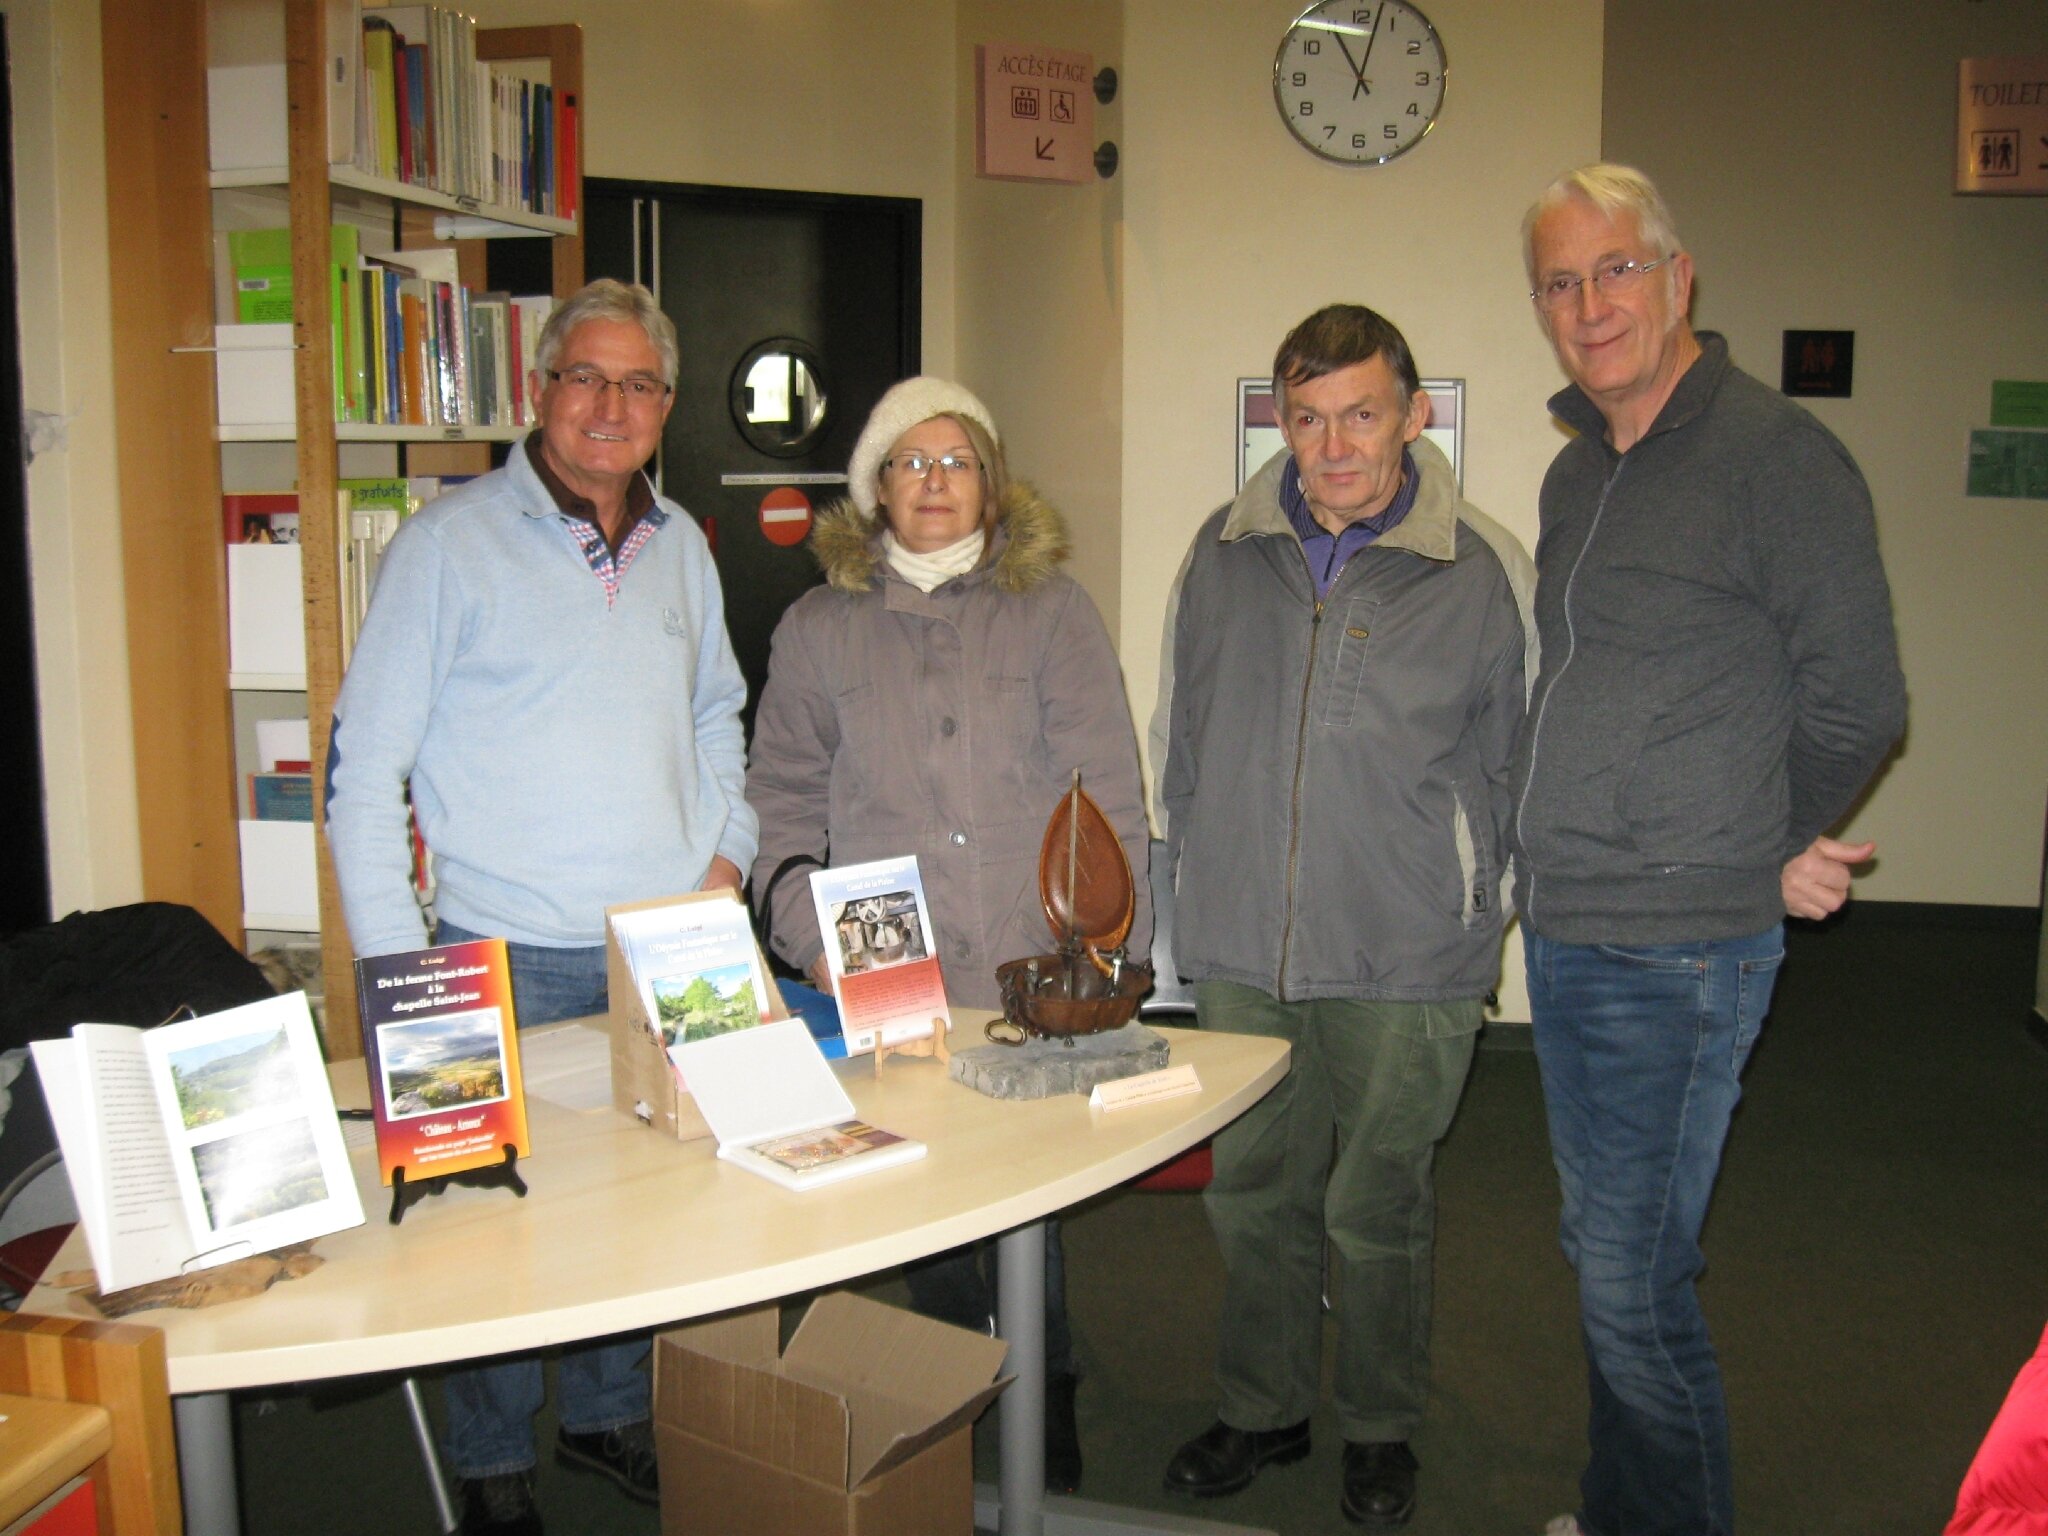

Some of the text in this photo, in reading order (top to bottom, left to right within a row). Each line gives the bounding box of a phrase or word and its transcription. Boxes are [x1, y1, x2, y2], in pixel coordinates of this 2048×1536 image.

[1352, 10, 1370, 24] 12
[1390, 17, 1395, 32] 1
[1303, 40, 1321, 55] 10
[1406, 41, 1421, 55] 2
[998, 54, 1044, 77] ACCÈS
[1292, 72, 1306, 87] 9
[1415, 72, 1430, 86] 3
[1300, 102, 1314, 116] 8
[1405, 103, 1419, 117] 4
[1323, 126, 1337, 139] 7
[1384, 125, 1398, 139] 5
[1352, 135, 1366, 148] 6
[377, 978, 393, 989] De
[393, 977, 405, 987] la
[405, 973, 433, 985] ferme
[435, 984, 444, 993] la
[391, 998, 432, 1013] chapelle
